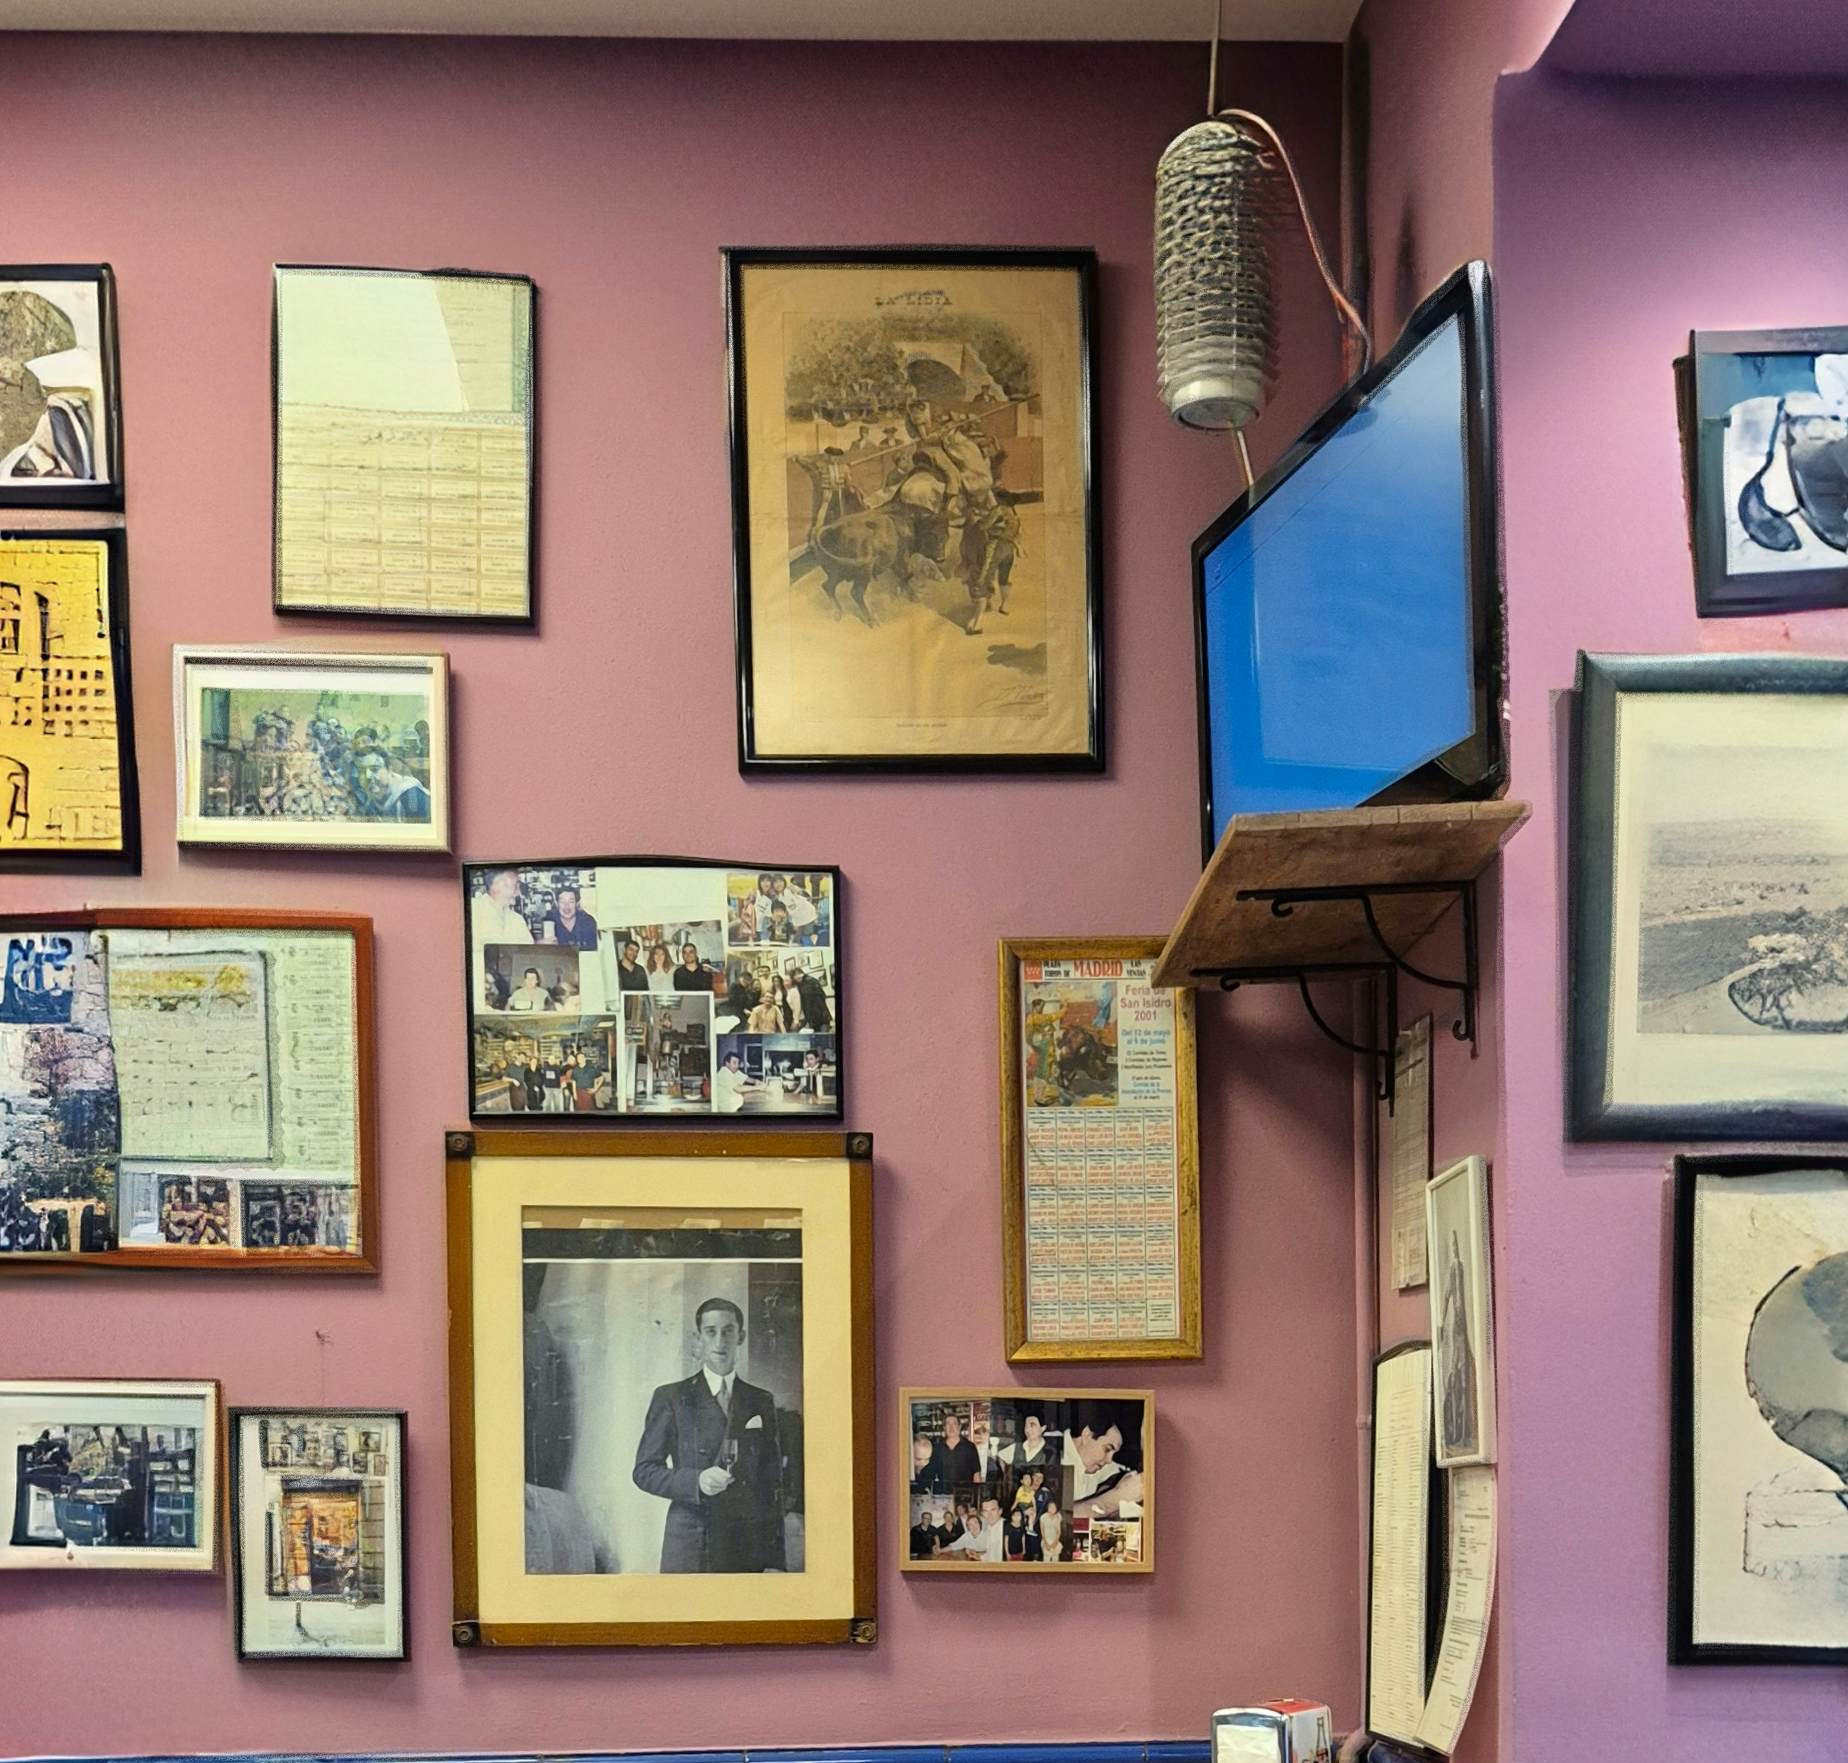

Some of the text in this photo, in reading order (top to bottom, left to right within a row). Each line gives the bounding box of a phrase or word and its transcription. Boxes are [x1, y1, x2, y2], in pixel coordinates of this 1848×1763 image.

[1073, 959, 1124, 977] MADRID
[1125, 984, 1150, 996] Feria
[1120, 997, 1171, 1009] San Isidro
[1134, 1010, 1157, 1021] 2001
